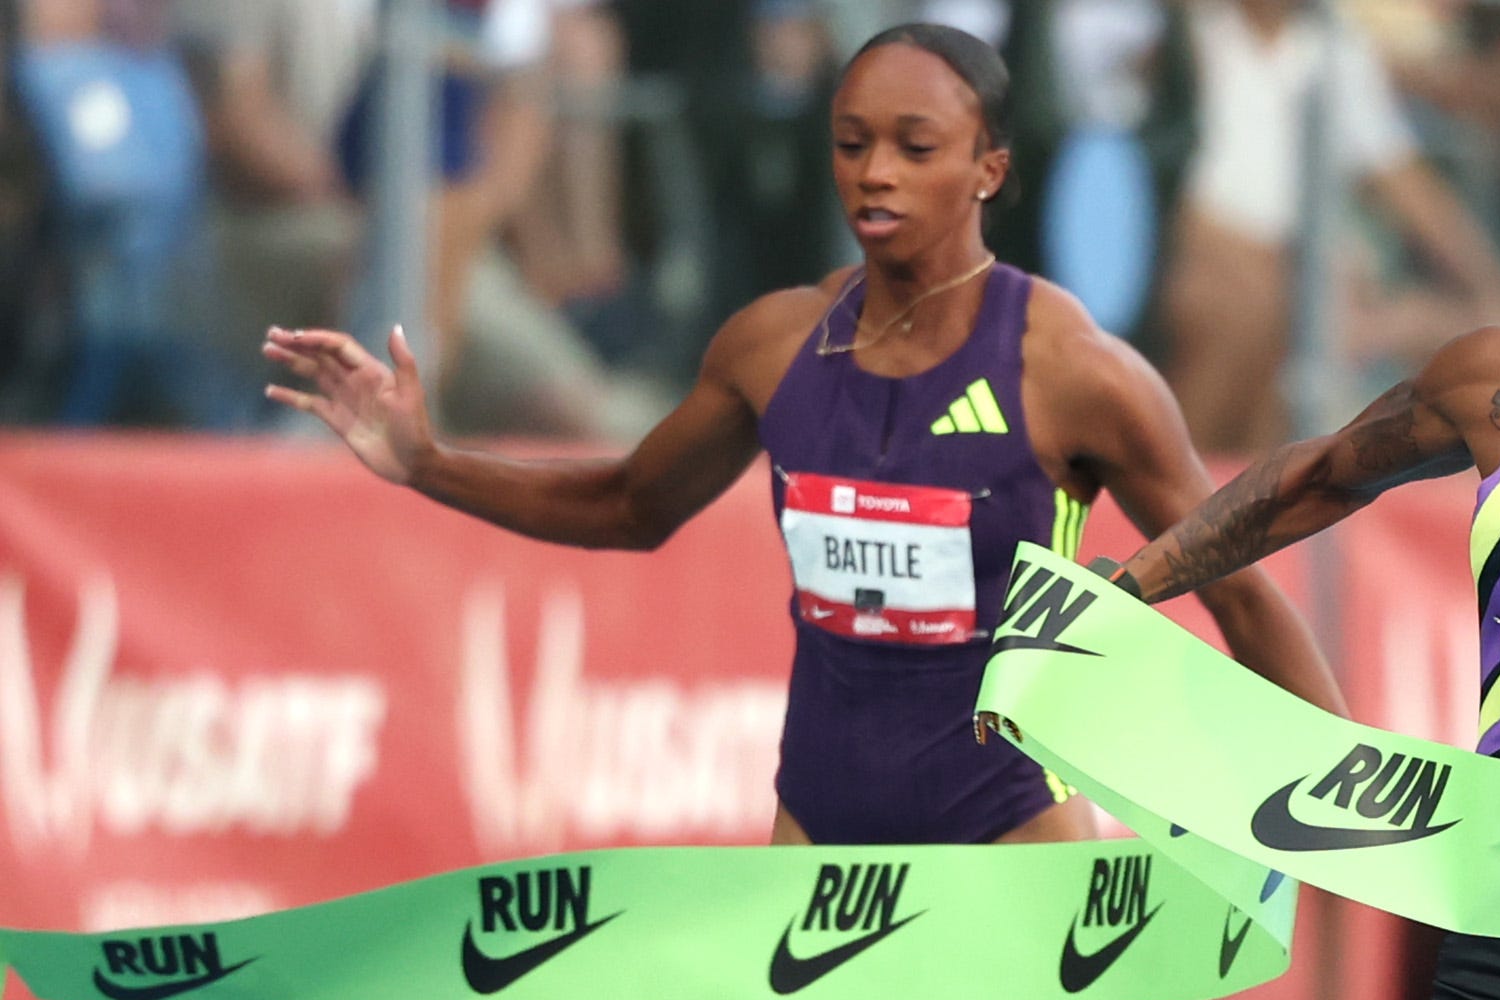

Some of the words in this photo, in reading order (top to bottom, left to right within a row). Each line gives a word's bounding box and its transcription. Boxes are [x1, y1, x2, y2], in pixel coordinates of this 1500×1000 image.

[858, 494, 910, 513] TOYOTA
[824, 535, 922, 580] BATTLE
[1000, 559, 1099, 640] UN
[1309, 742, 1453, 832] RUN
[478, 866, 592, 932] RUN
[801, 863, 910, 932] RUN
[1083, 854, 1152, 928] RUN
[101, 933, 221, 978] RUN
